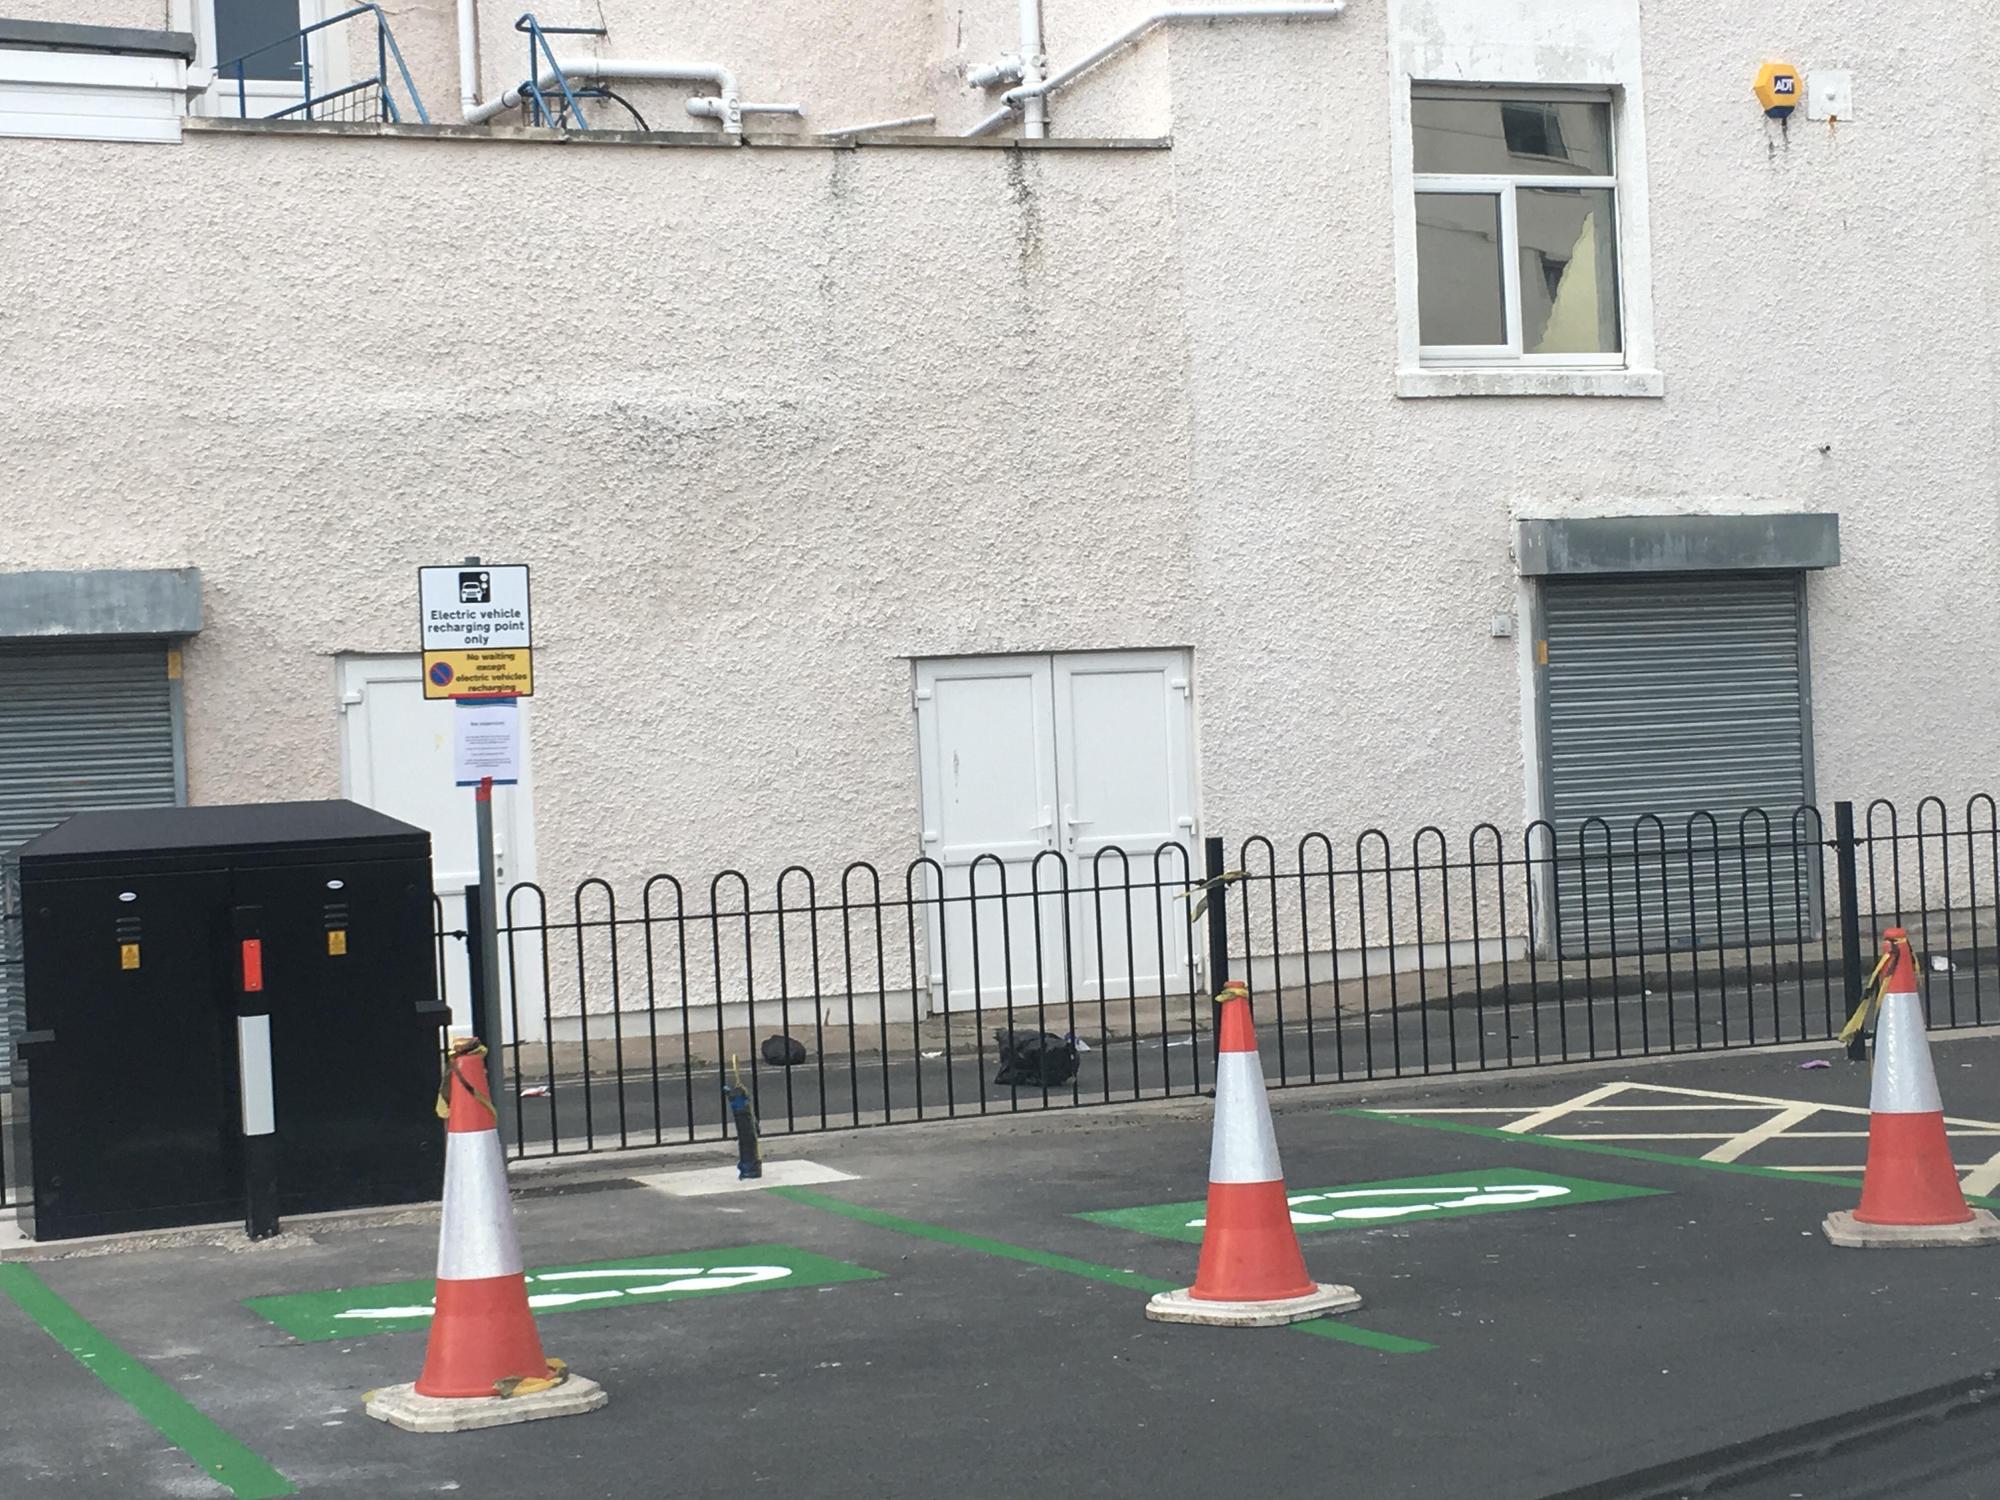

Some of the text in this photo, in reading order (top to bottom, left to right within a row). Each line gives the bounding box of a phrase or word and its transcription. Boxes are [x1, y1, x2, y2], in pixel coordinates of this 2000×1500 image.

[1774, 78, 1793, 91] ADT
[431, 608, 521, 620] Electric vehicle
[428, 621, 524, 633] recharging point
[464, 634, 489, 645] only
[481, 652, 515, 661] waiting
[456, 672, 527, 682] electric vehicles
[468, 684, 516, 693] recharging
